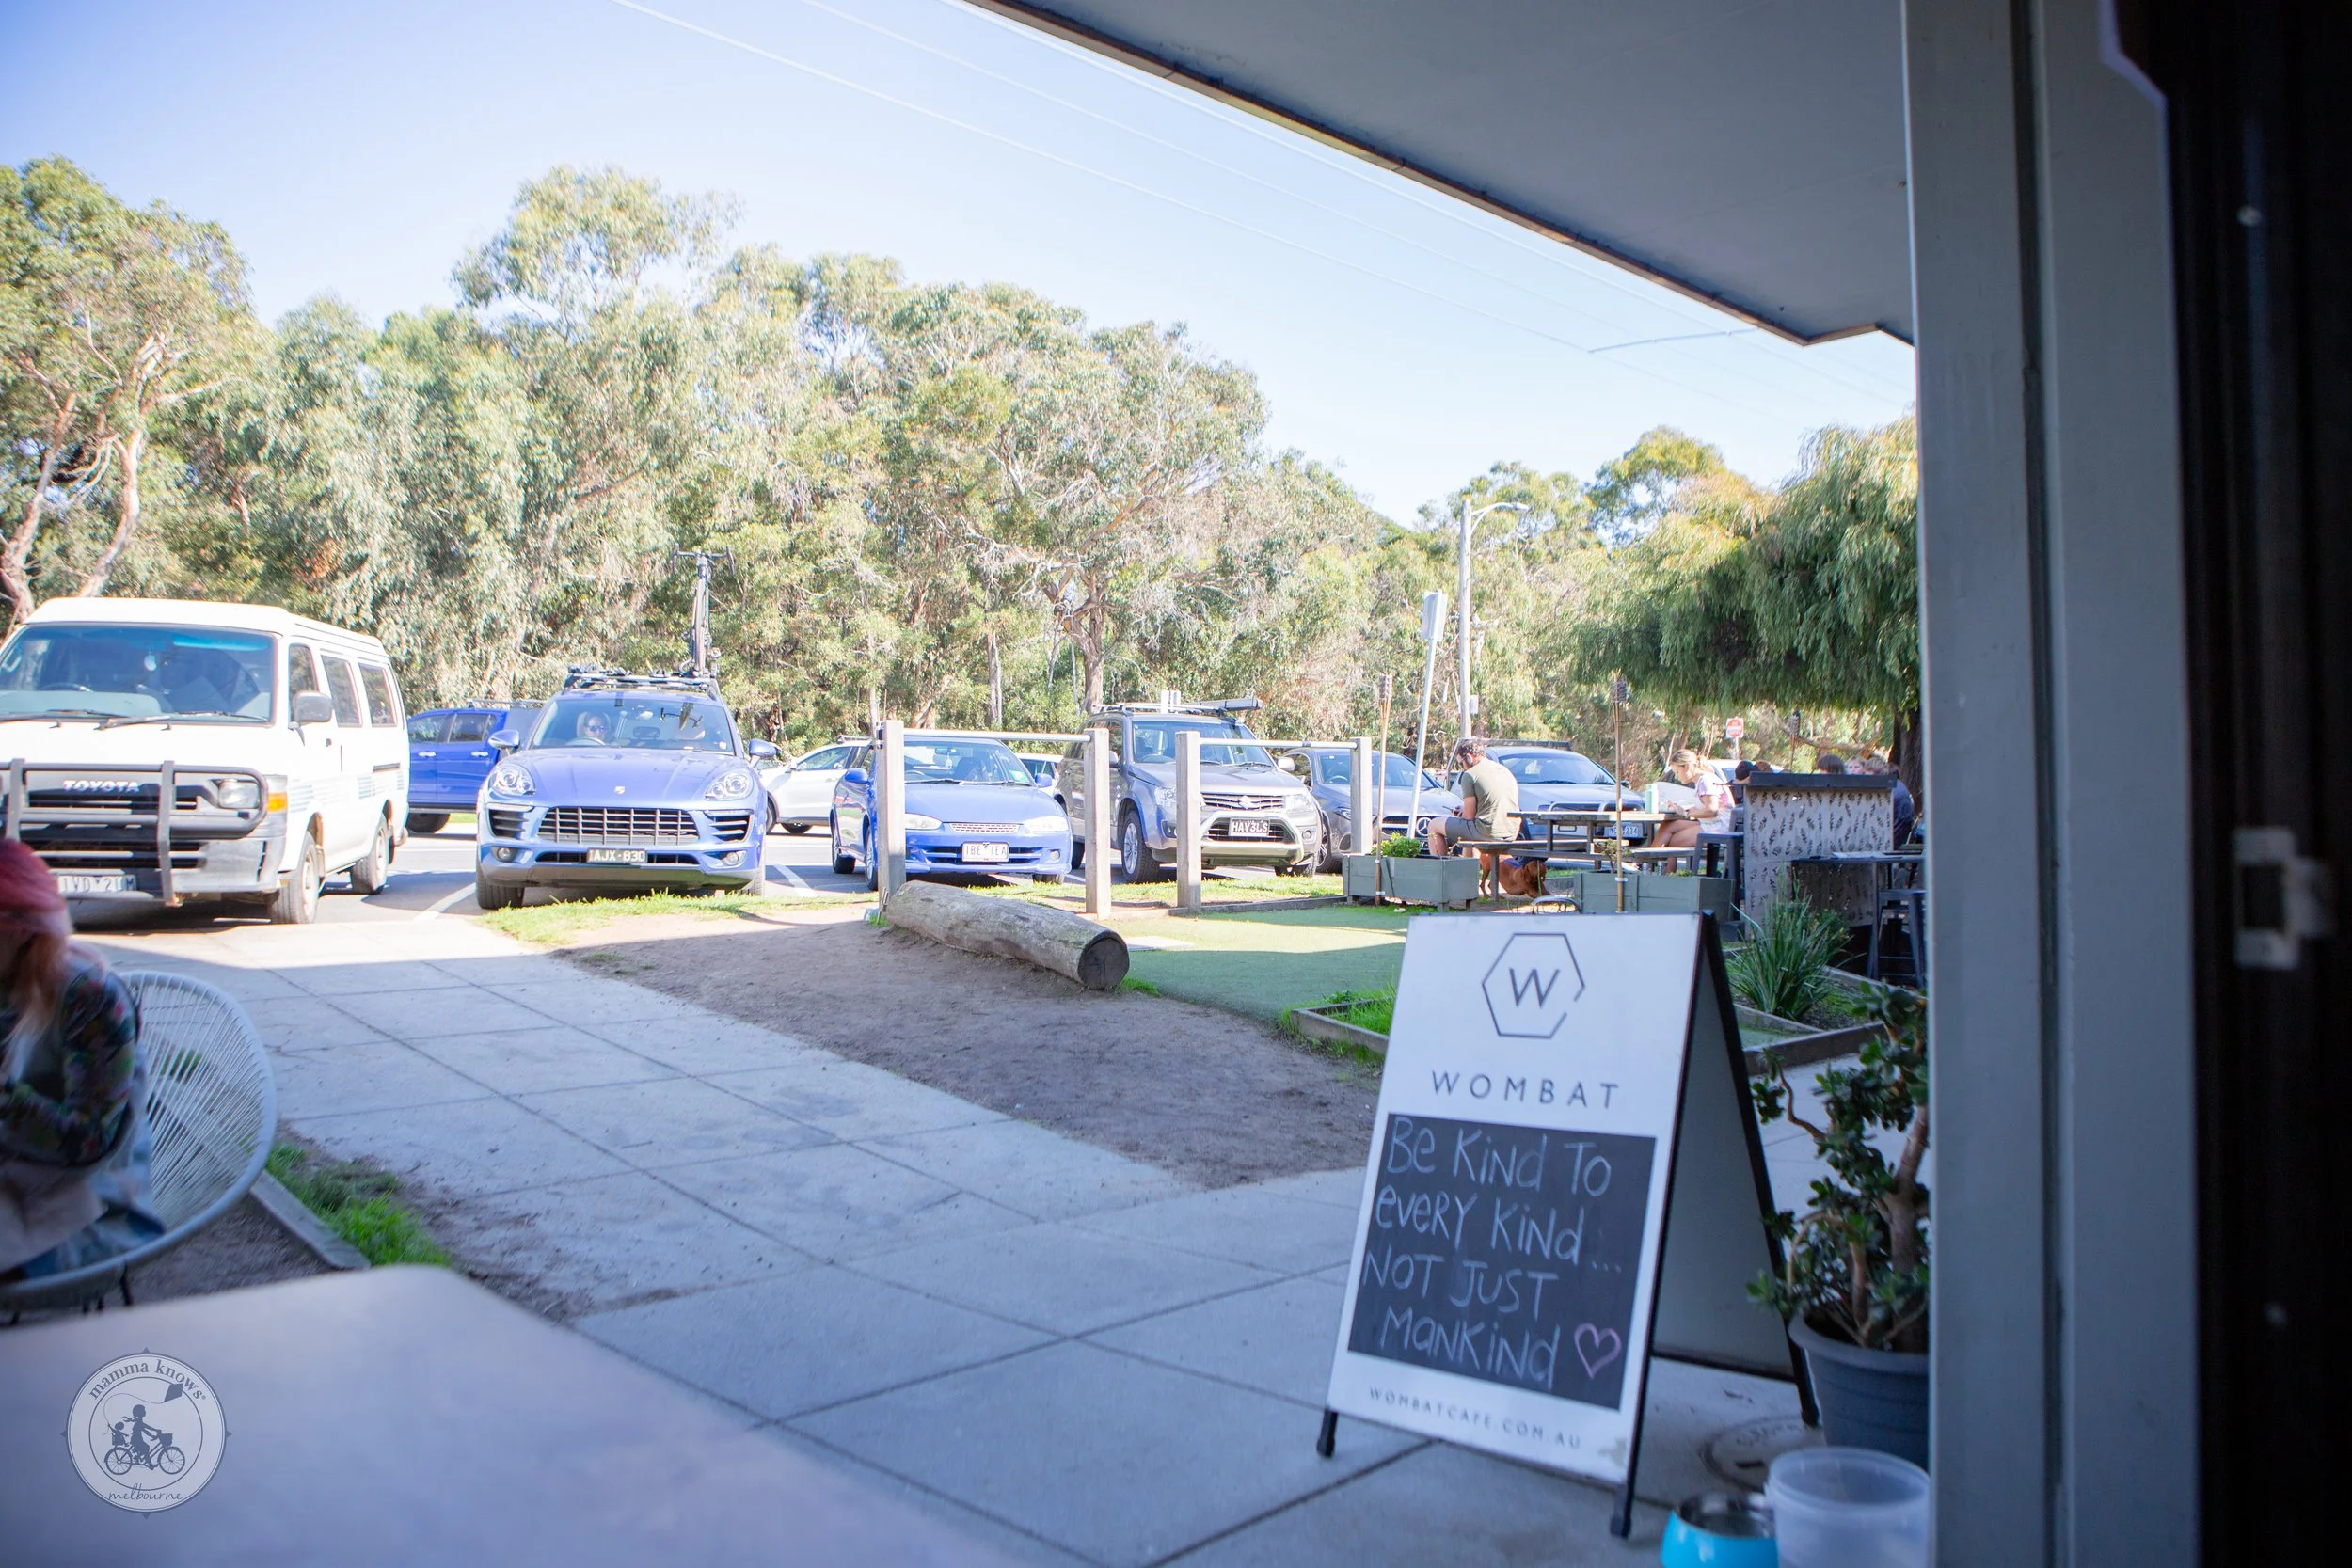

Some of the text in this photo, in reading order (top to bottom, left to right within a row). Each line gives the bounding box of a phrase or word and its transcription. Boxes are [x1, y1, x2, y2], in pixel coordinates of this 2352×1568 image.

[62, 779, 140, 793] TOYOTA
[1508, 967, 1561, 1009] W
[1432, 1069, 1619, 1109] WOMBAT
[1386, 1116, 1436, 1174] Be
[1362, 1245, 1560, 1323] NOT JUST
[1370, 1386, 1581, 1449] WOMBATCAFE.COM.AU
